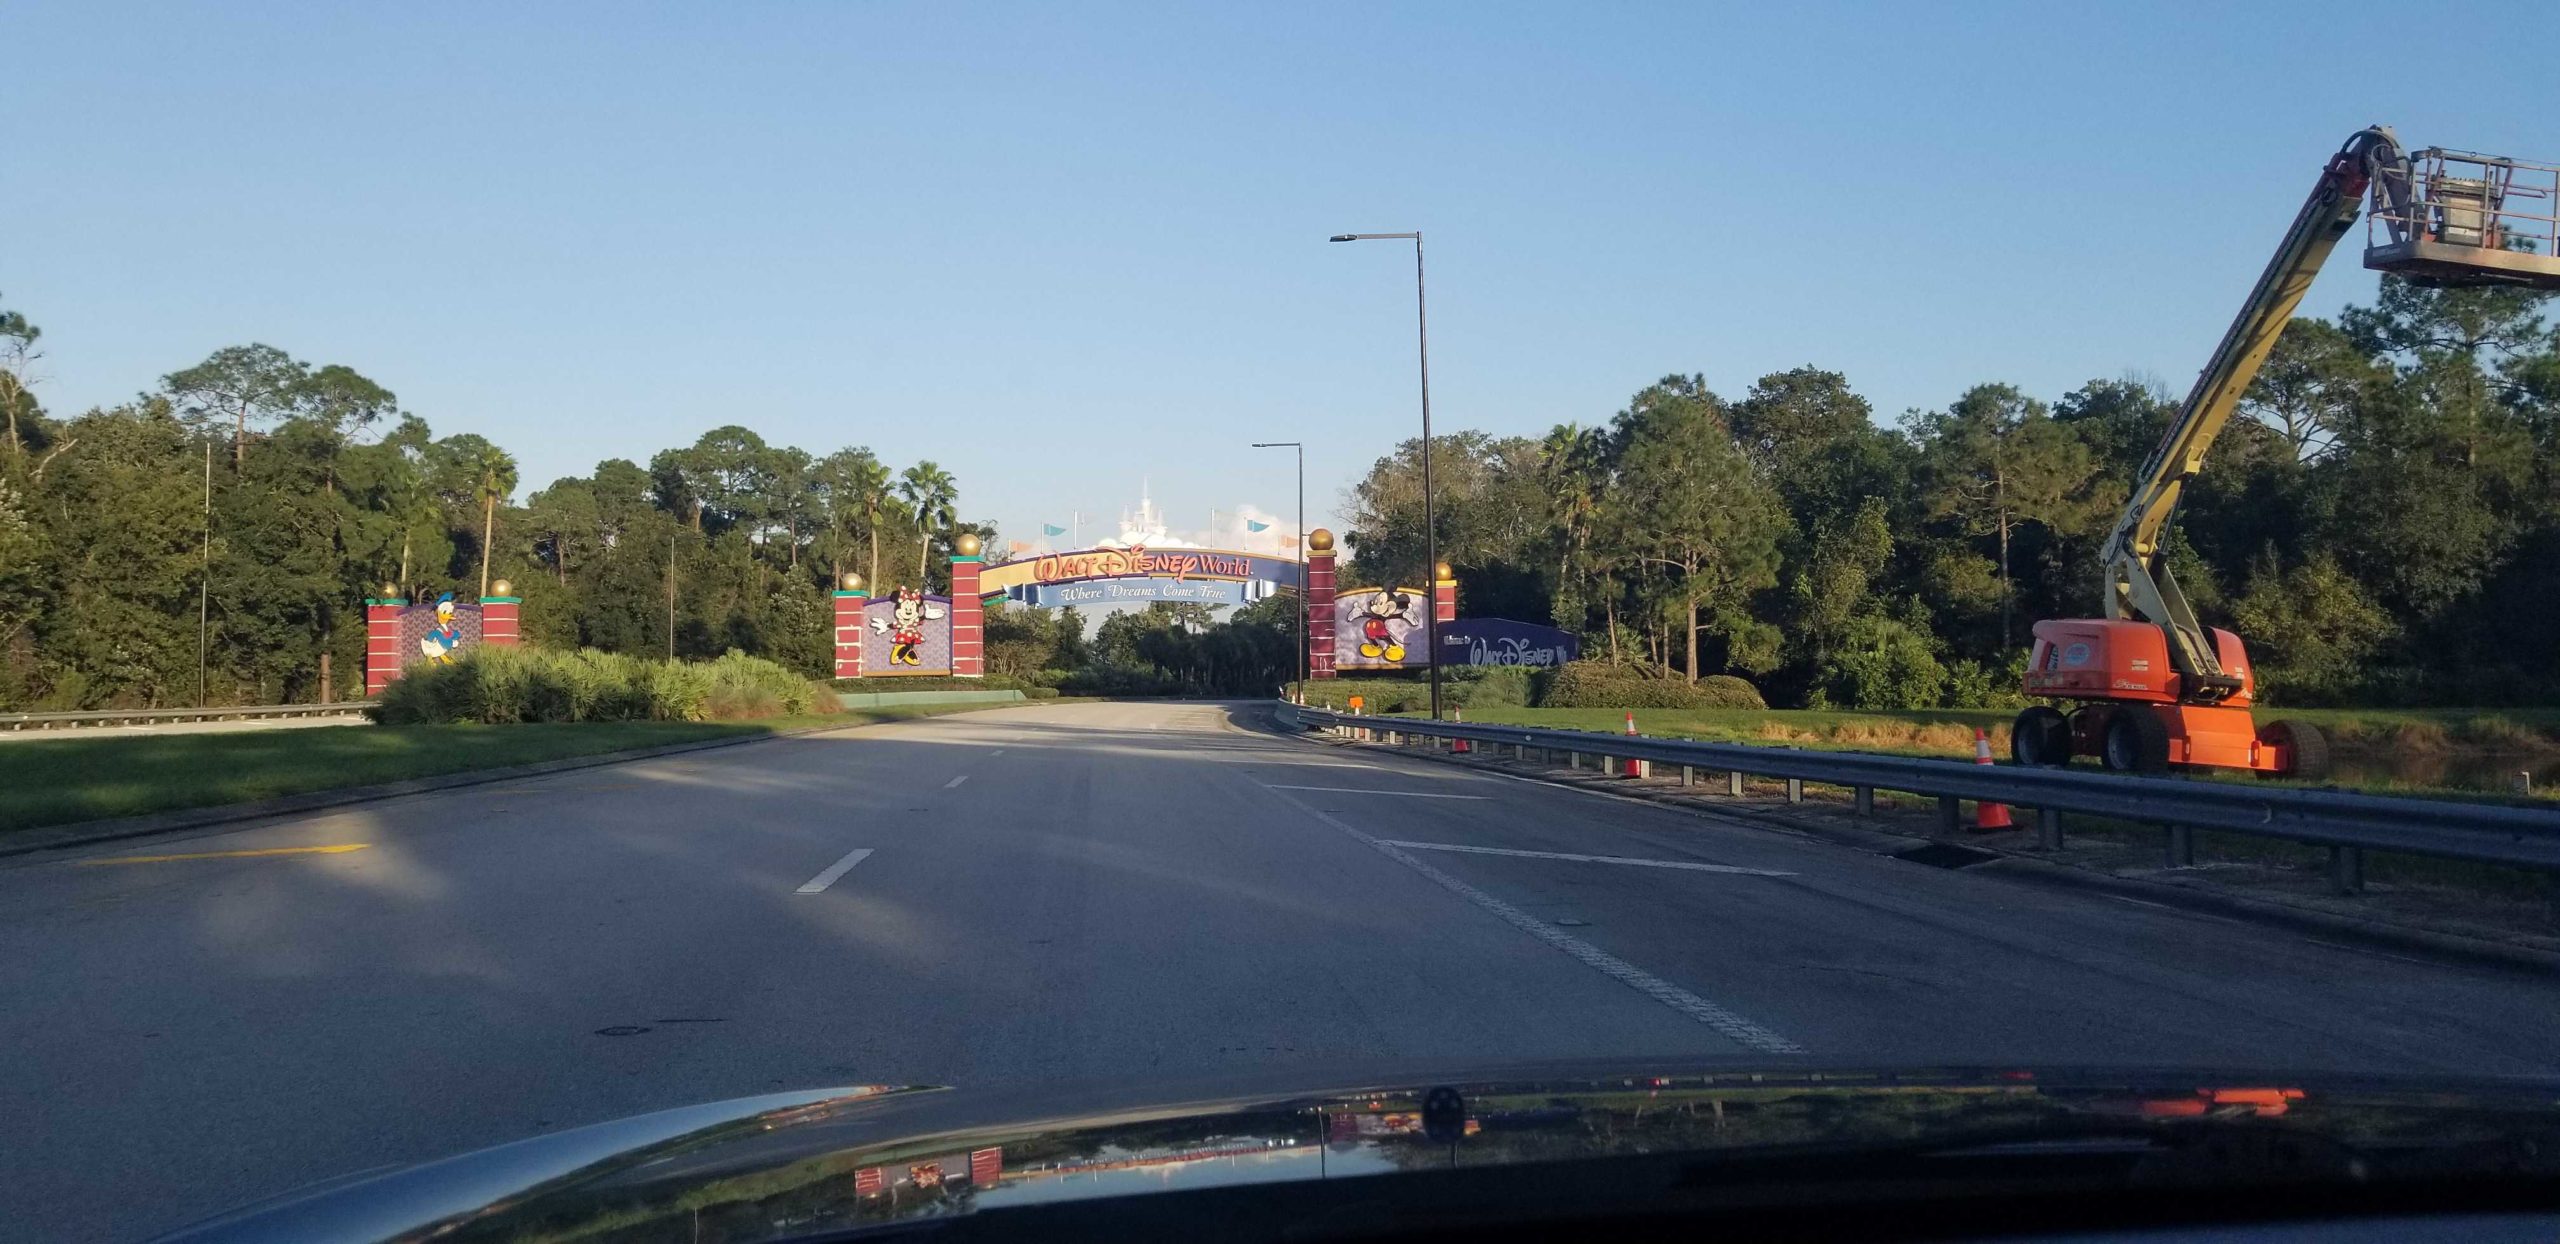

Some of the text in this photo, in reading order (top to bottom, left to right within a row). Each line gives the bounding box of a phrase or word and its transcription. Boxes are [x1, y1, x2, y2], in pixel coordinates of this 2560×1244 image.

[1061, 584, 1226, 601] Where Dreams Come True
